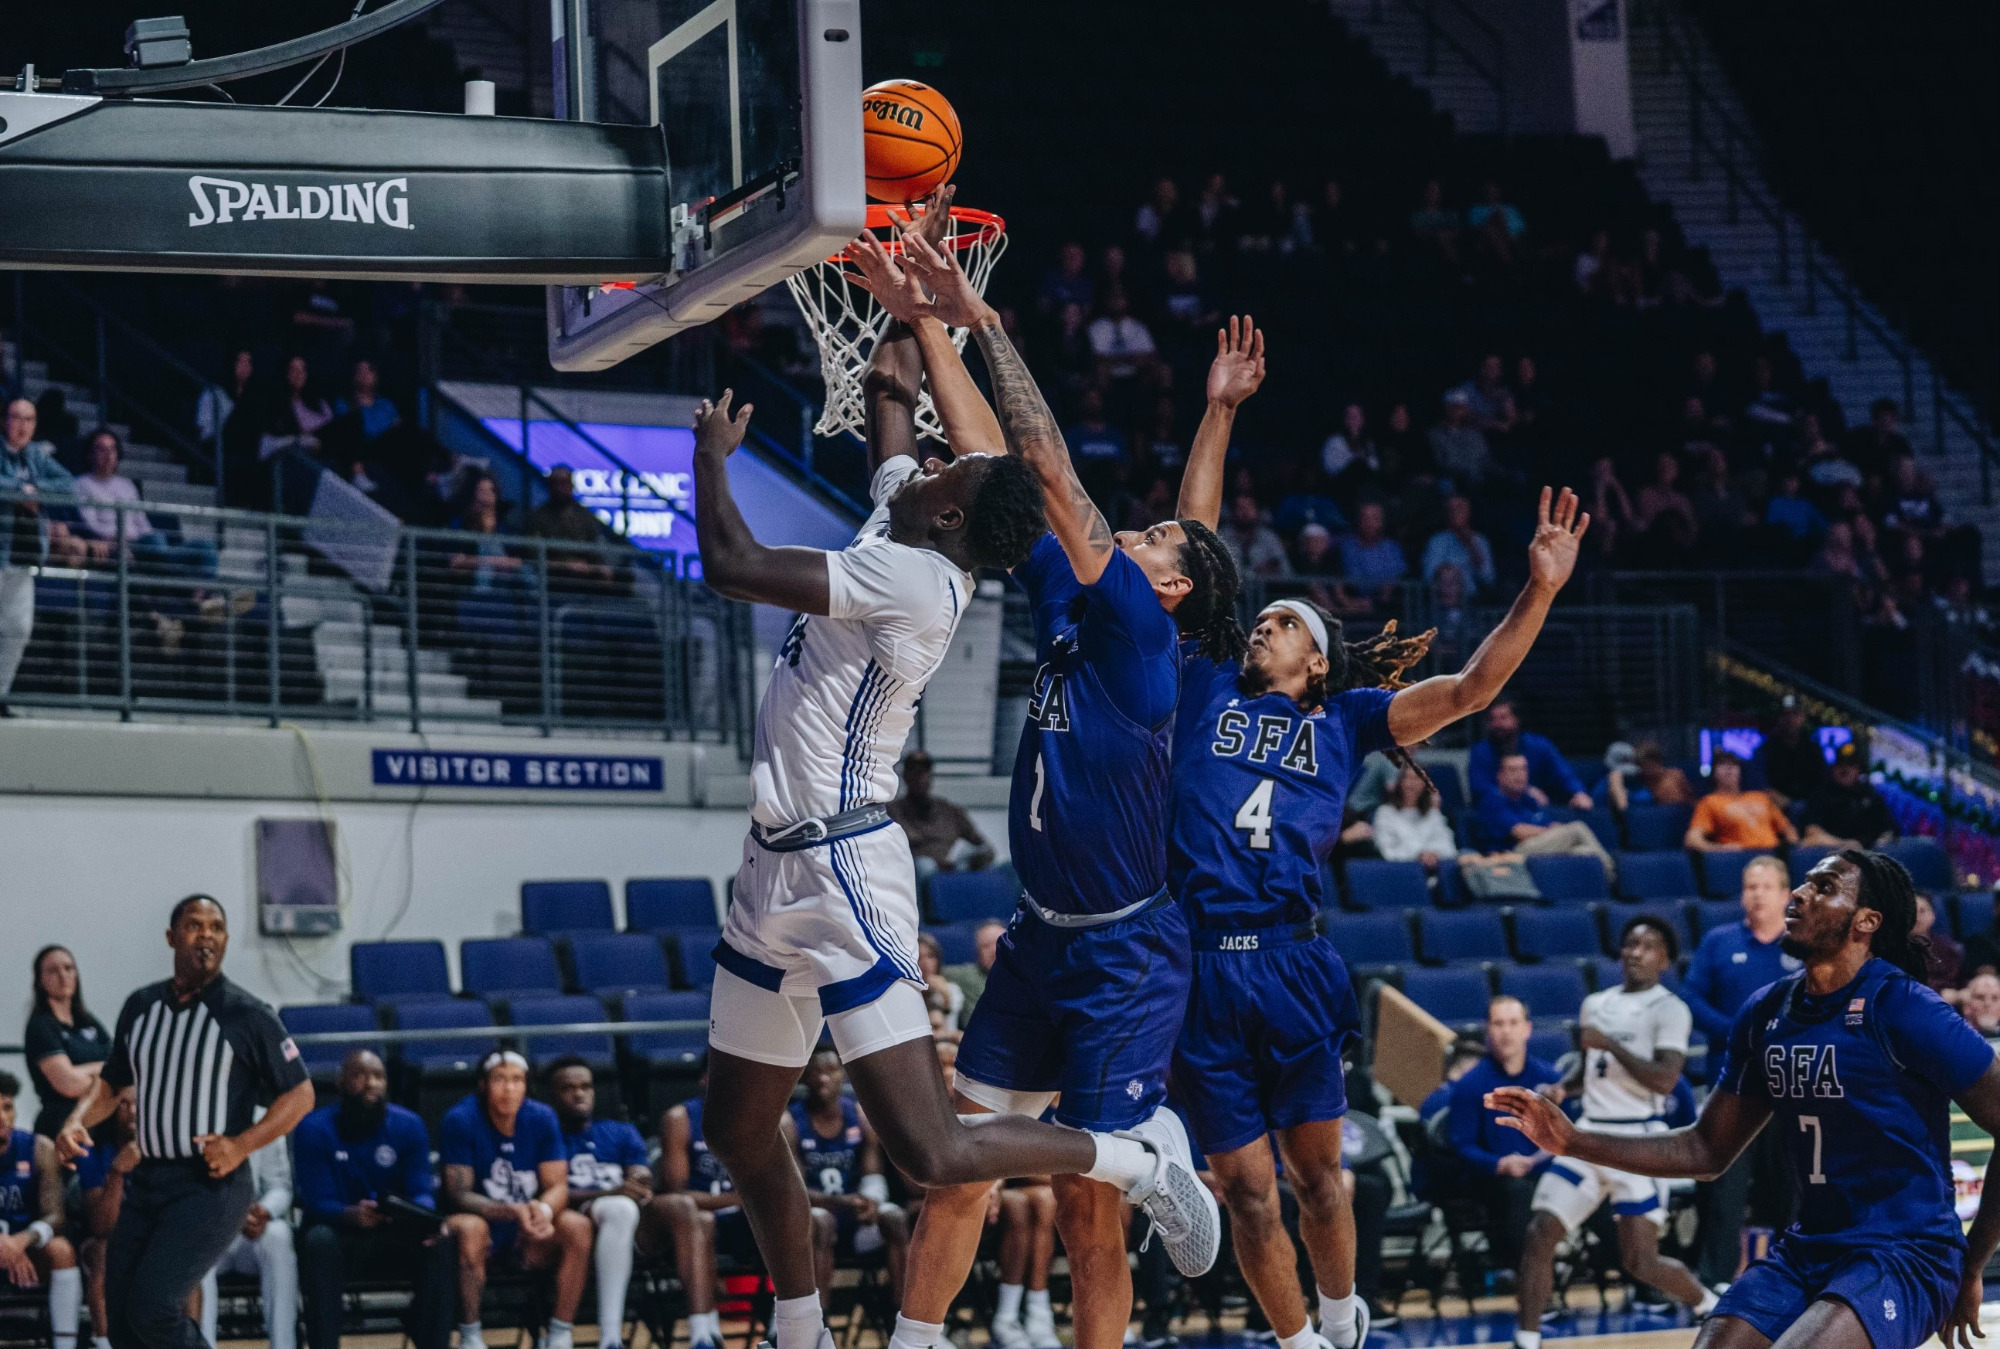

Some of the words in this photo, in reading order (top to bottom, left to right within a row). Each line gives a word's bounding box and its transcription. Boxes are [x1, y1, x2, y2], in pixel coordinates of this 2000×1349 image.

[863, 99, 923, 131] Wilso
[188, 175, 410, 229] SPALDING
[1212, 709, 1319, 776] SFA
[386, 755, 511, 783] VISITOR
[524, 760, 650, 785] SECTION
[1030, 752, 1044, 832] 1
[1235, 779, 1274, 849] 4
[1219, 935, 1259, 950] JACKS
[1765, 1045, 1844, 1098] SFA
[1798, 1115, 1827, 1184] 7
